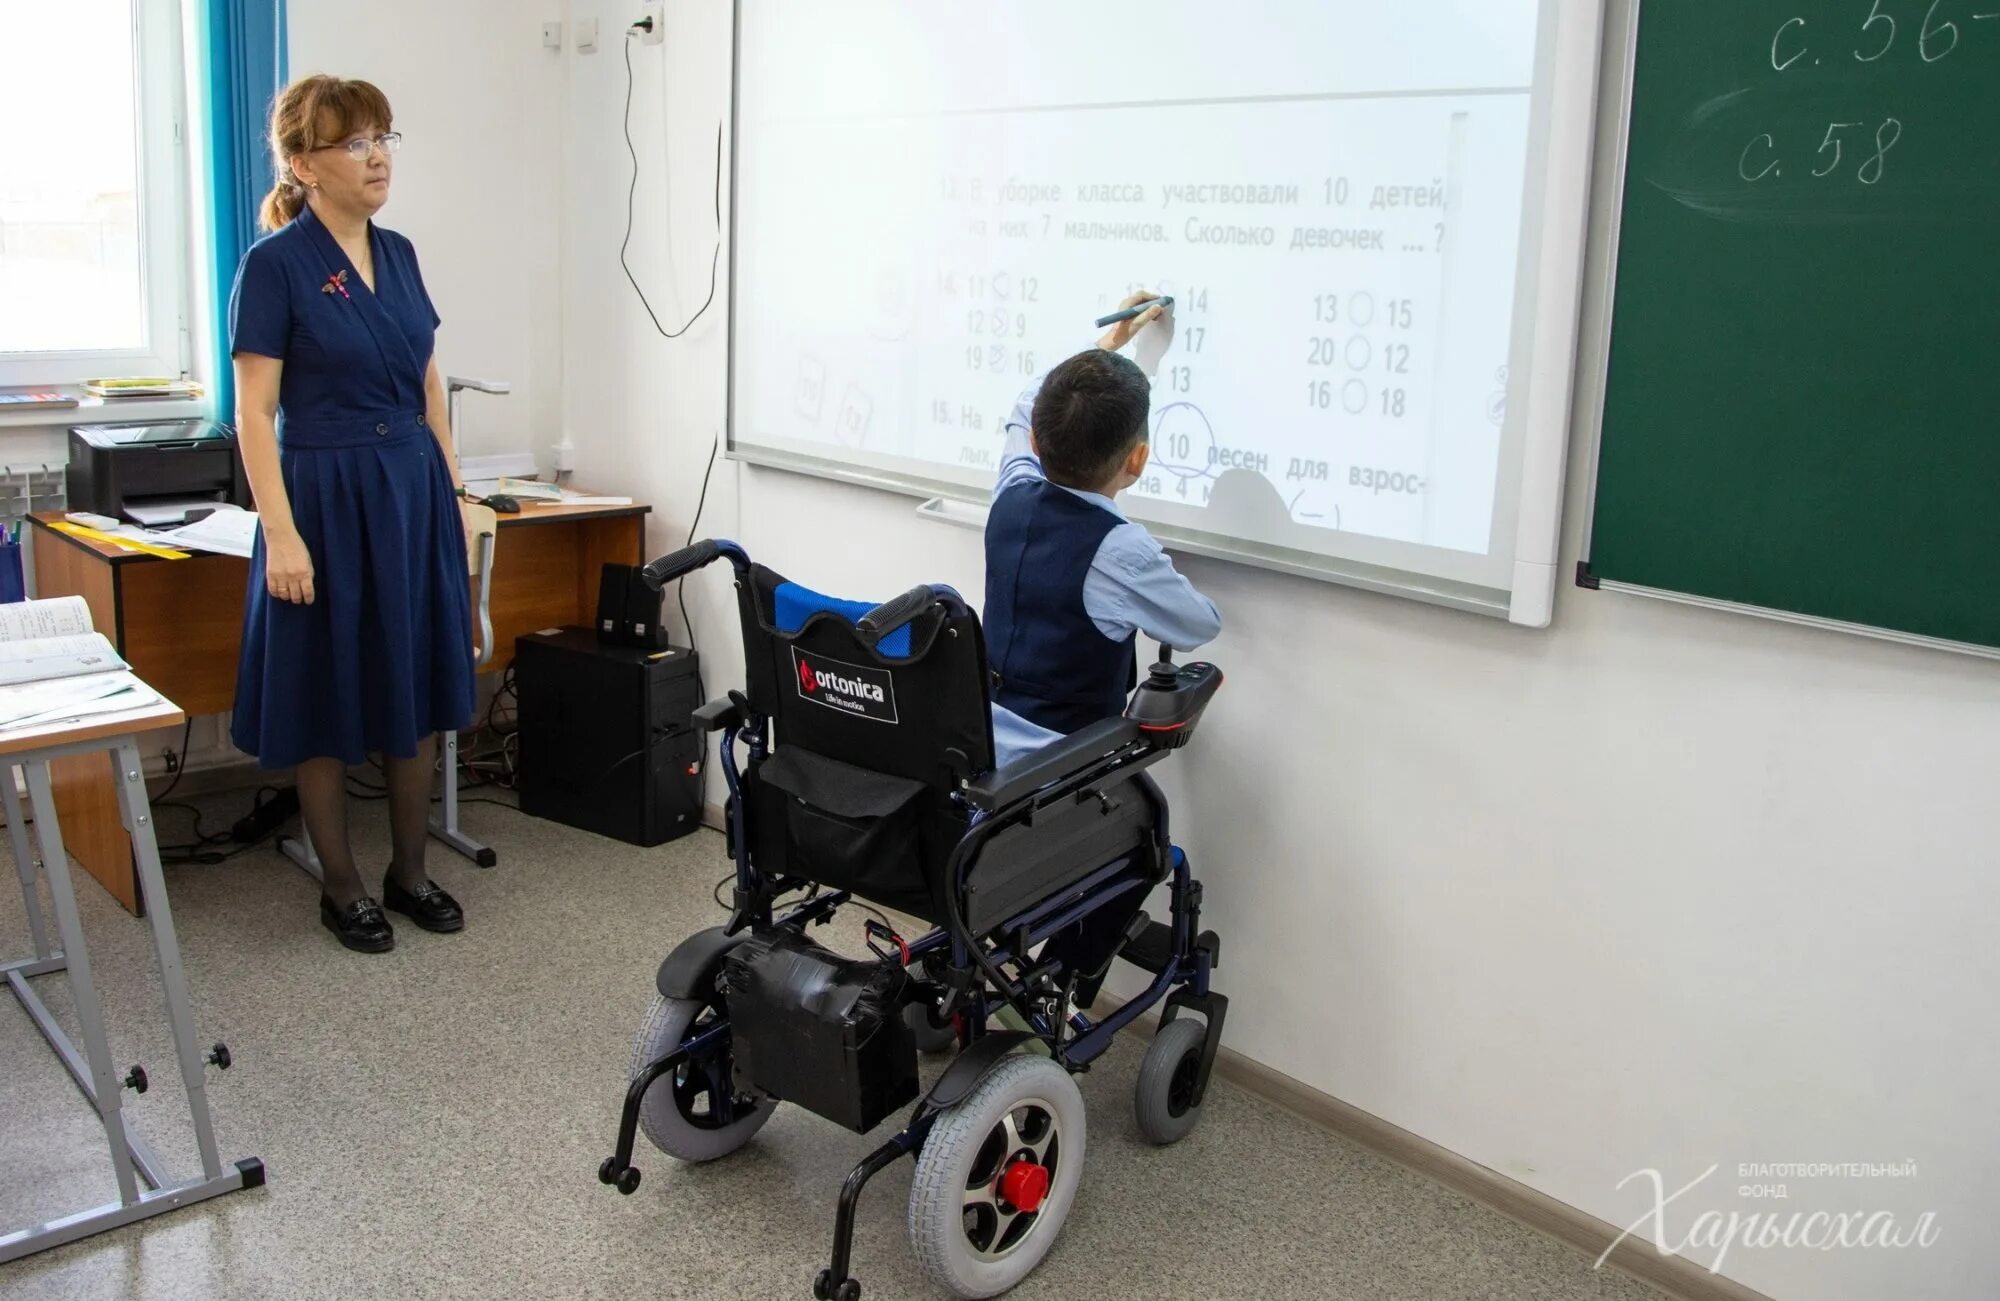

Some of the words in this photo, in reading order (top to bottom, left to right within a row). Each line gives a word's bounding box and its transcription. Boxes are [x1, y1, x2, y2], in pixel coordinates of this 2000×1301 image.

[1811, 117, 1901, 184] 58
[996, 174, 1062, 208] уборке
[1077, 183, 1144, 204] класса
[1162, 182, 1300, 208] участвовали
[1323, 176, 1349, 206] 10
[999, 221, 1029, 239] них
[1041, 213, 1052, 238] 7
[1064, 219, 1169, 243] мальчиков.
[1184, 216, 1276, 246] Сколько
[1289, 224, 1385, 251] девочек
[968, 274, 985, 299] 11
[1020, 276, 1039, 302] 12
[1187, 286, 1208, 313] 14
[967, 309, 985, 334] 12
[1015, 312, 1026, 338] 9
[1312, 293, 1338, 323] 13
[1388, 298, 1413, 330] 15
[1184, 326, 1206, 353] 17
[1306, 337, 1335, 366] 20
[1384, 344, 1410, 374] 12
[965, 344, 982, 370] 19
[1016, 350, 1035, 377] 16
[1170, 365, 1191, 393] 13
[1307, 380, 1332, 409] 16
[1381, 387, 1406, 418] 18
[931, 398, 952, 425] 15.
[960, 403, 983, 430] На
[1168, 432, 1190, 460] 10
[1207, 445, 1269, 472] песен
[1286, 457, 1329, 482] для
[1348, 464, 1428, 496] взрос-
[1138, 475, 1162, 495] на
[1175, 473, 1188, 499] 4
[815, 670, 885, 703] ortonica
